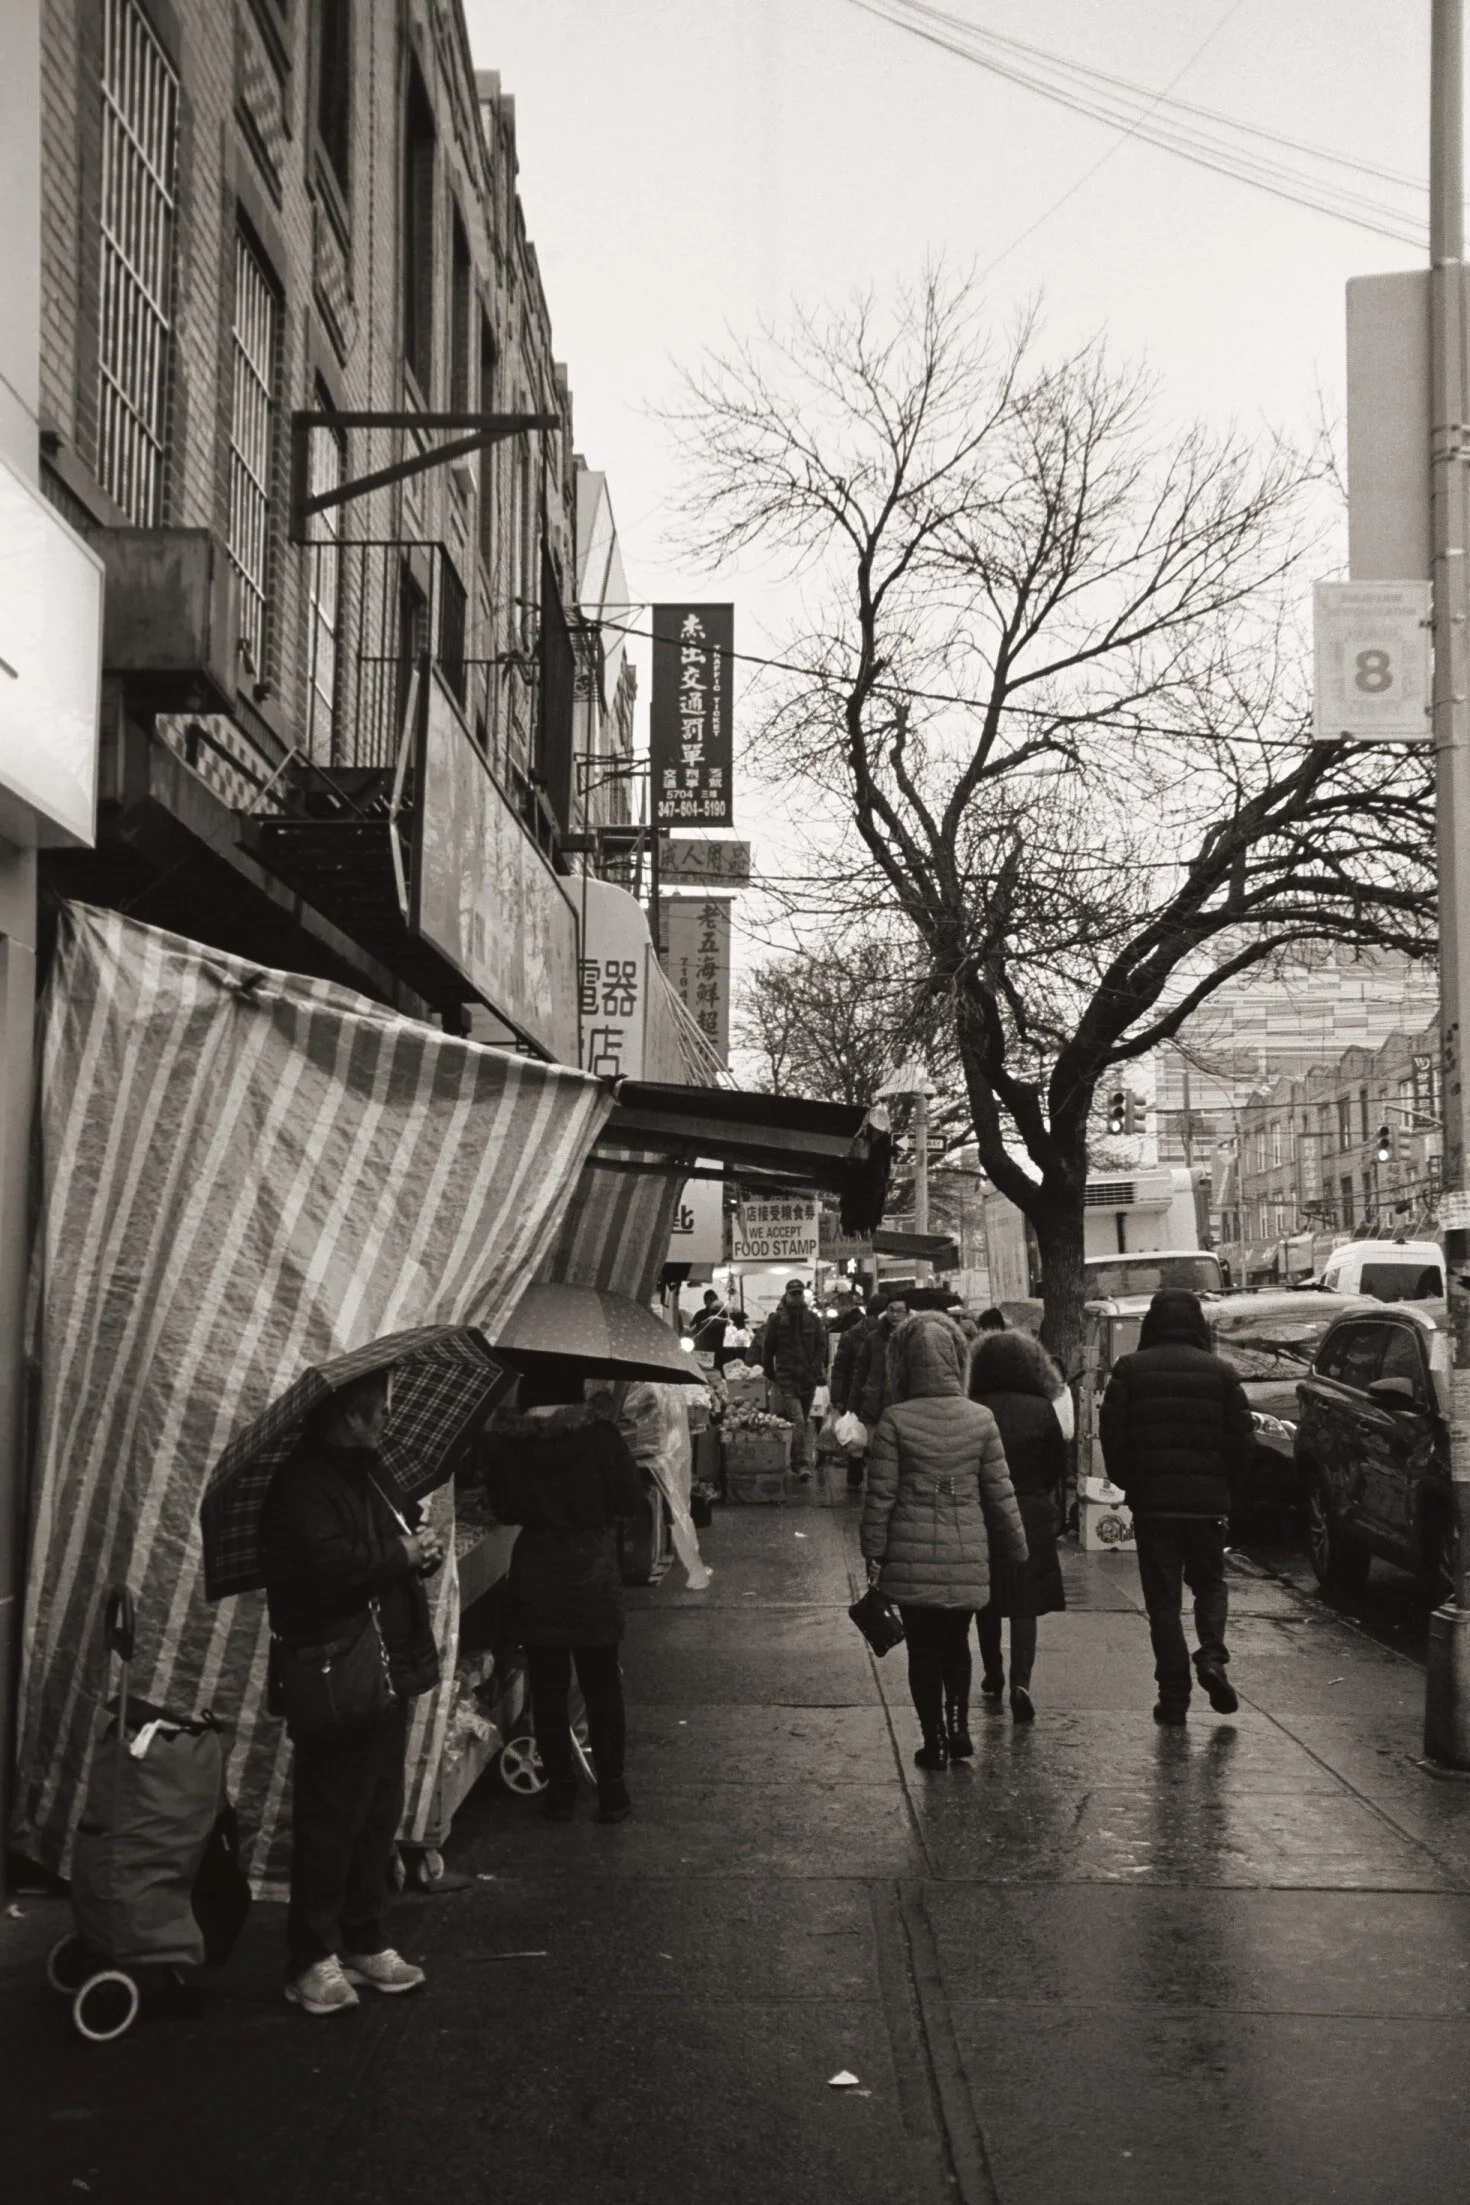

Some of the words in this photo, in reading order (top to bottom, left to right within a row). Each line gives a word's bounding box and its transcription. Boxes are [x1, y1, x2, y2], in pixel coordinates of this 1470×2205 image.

[1355, 650, 1393, 693] 8
[711, 696, 721, 738] TICKET
[666, 789, 693, 799] 5704
[750, 1227, 763, 1239] WE
[767, 1225, 802, 1239] ACCEPT
[735, 1240, 769, 1256] FOOD
[773, 1239, 817, 1255] STAMP
